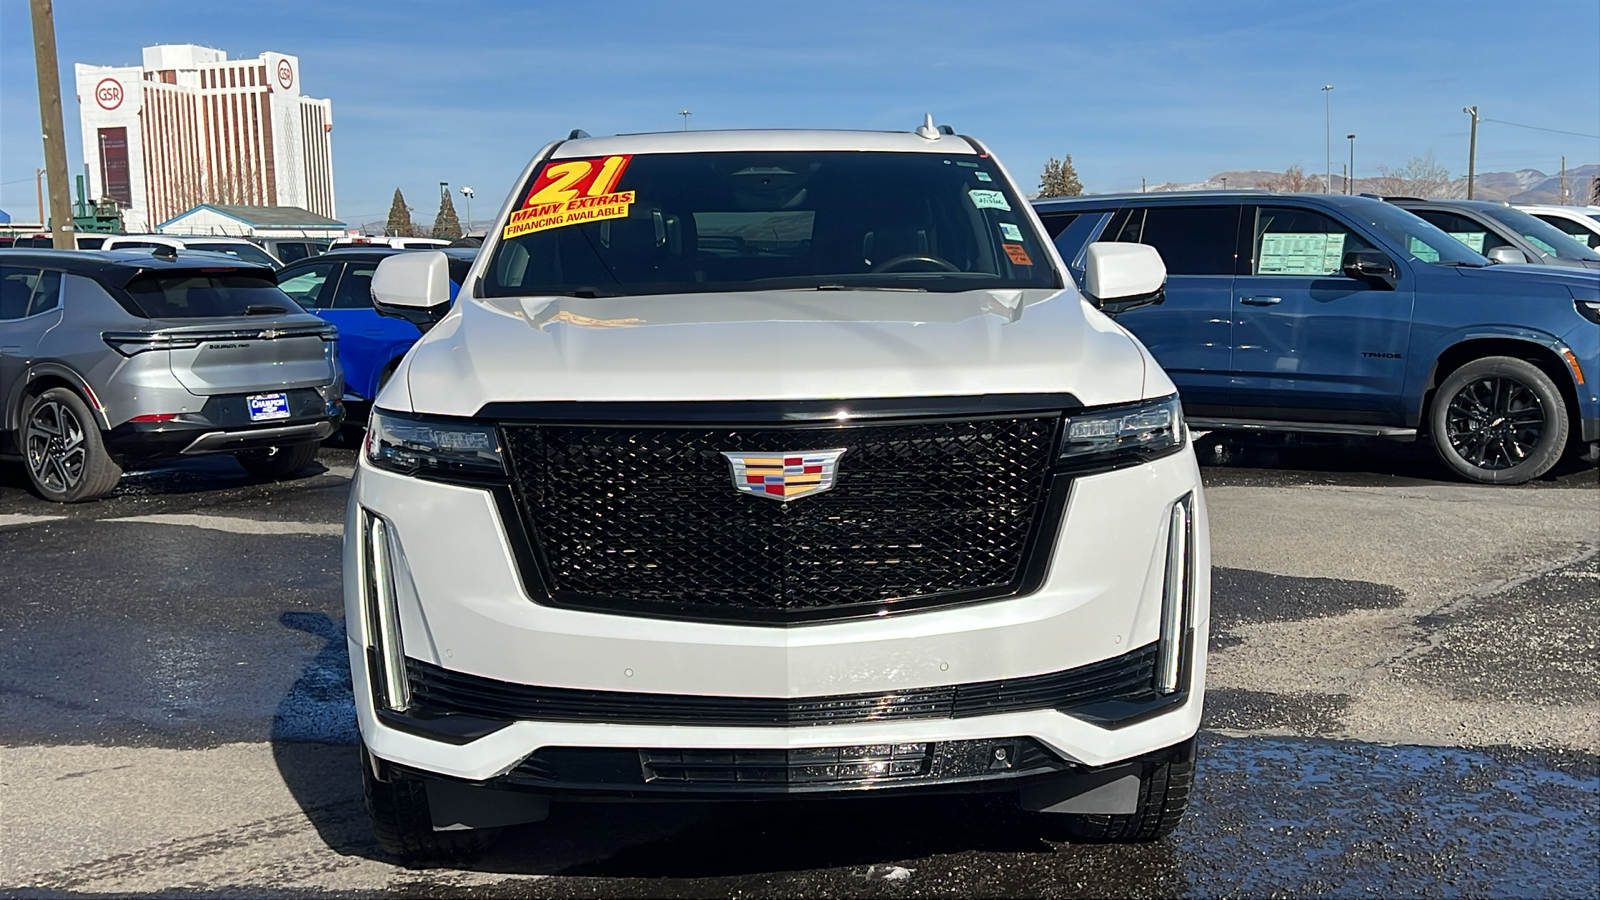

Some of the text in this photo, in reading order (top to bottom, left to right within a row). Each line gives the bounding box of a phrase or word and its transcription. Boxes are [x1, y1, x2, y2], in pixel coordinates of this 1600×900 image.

[98, 87, 120, 101] GSR
[528, 155, 628, 206] 21
[506, 206, 625, 236] FINANCING AVAILABLE
[511, 192, 632, 223] MANY EXTRAS
[251, 398, 285, 409] CHAMPION
